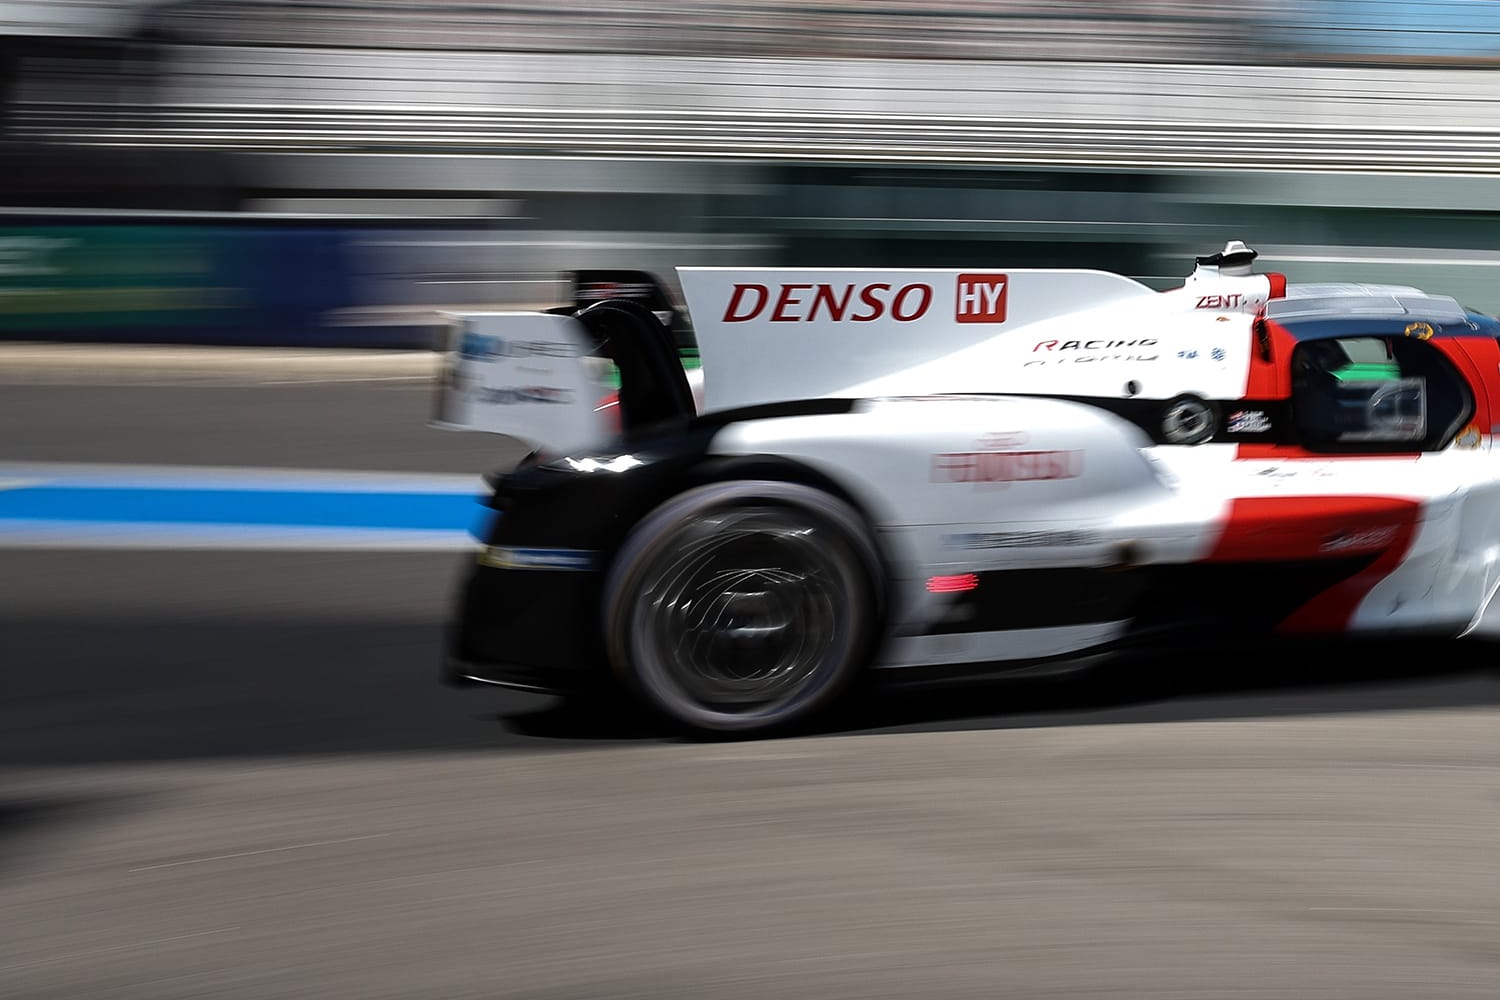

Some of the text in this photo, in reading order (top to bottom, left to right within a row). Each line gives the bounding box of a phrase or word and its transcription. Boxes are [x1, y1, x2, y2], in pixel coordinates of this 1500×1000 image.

[722, 283, 934, 322] DENSO
[958, 282, 1005, 315] HY
[1195, 294, 1243, 309] ZENT
